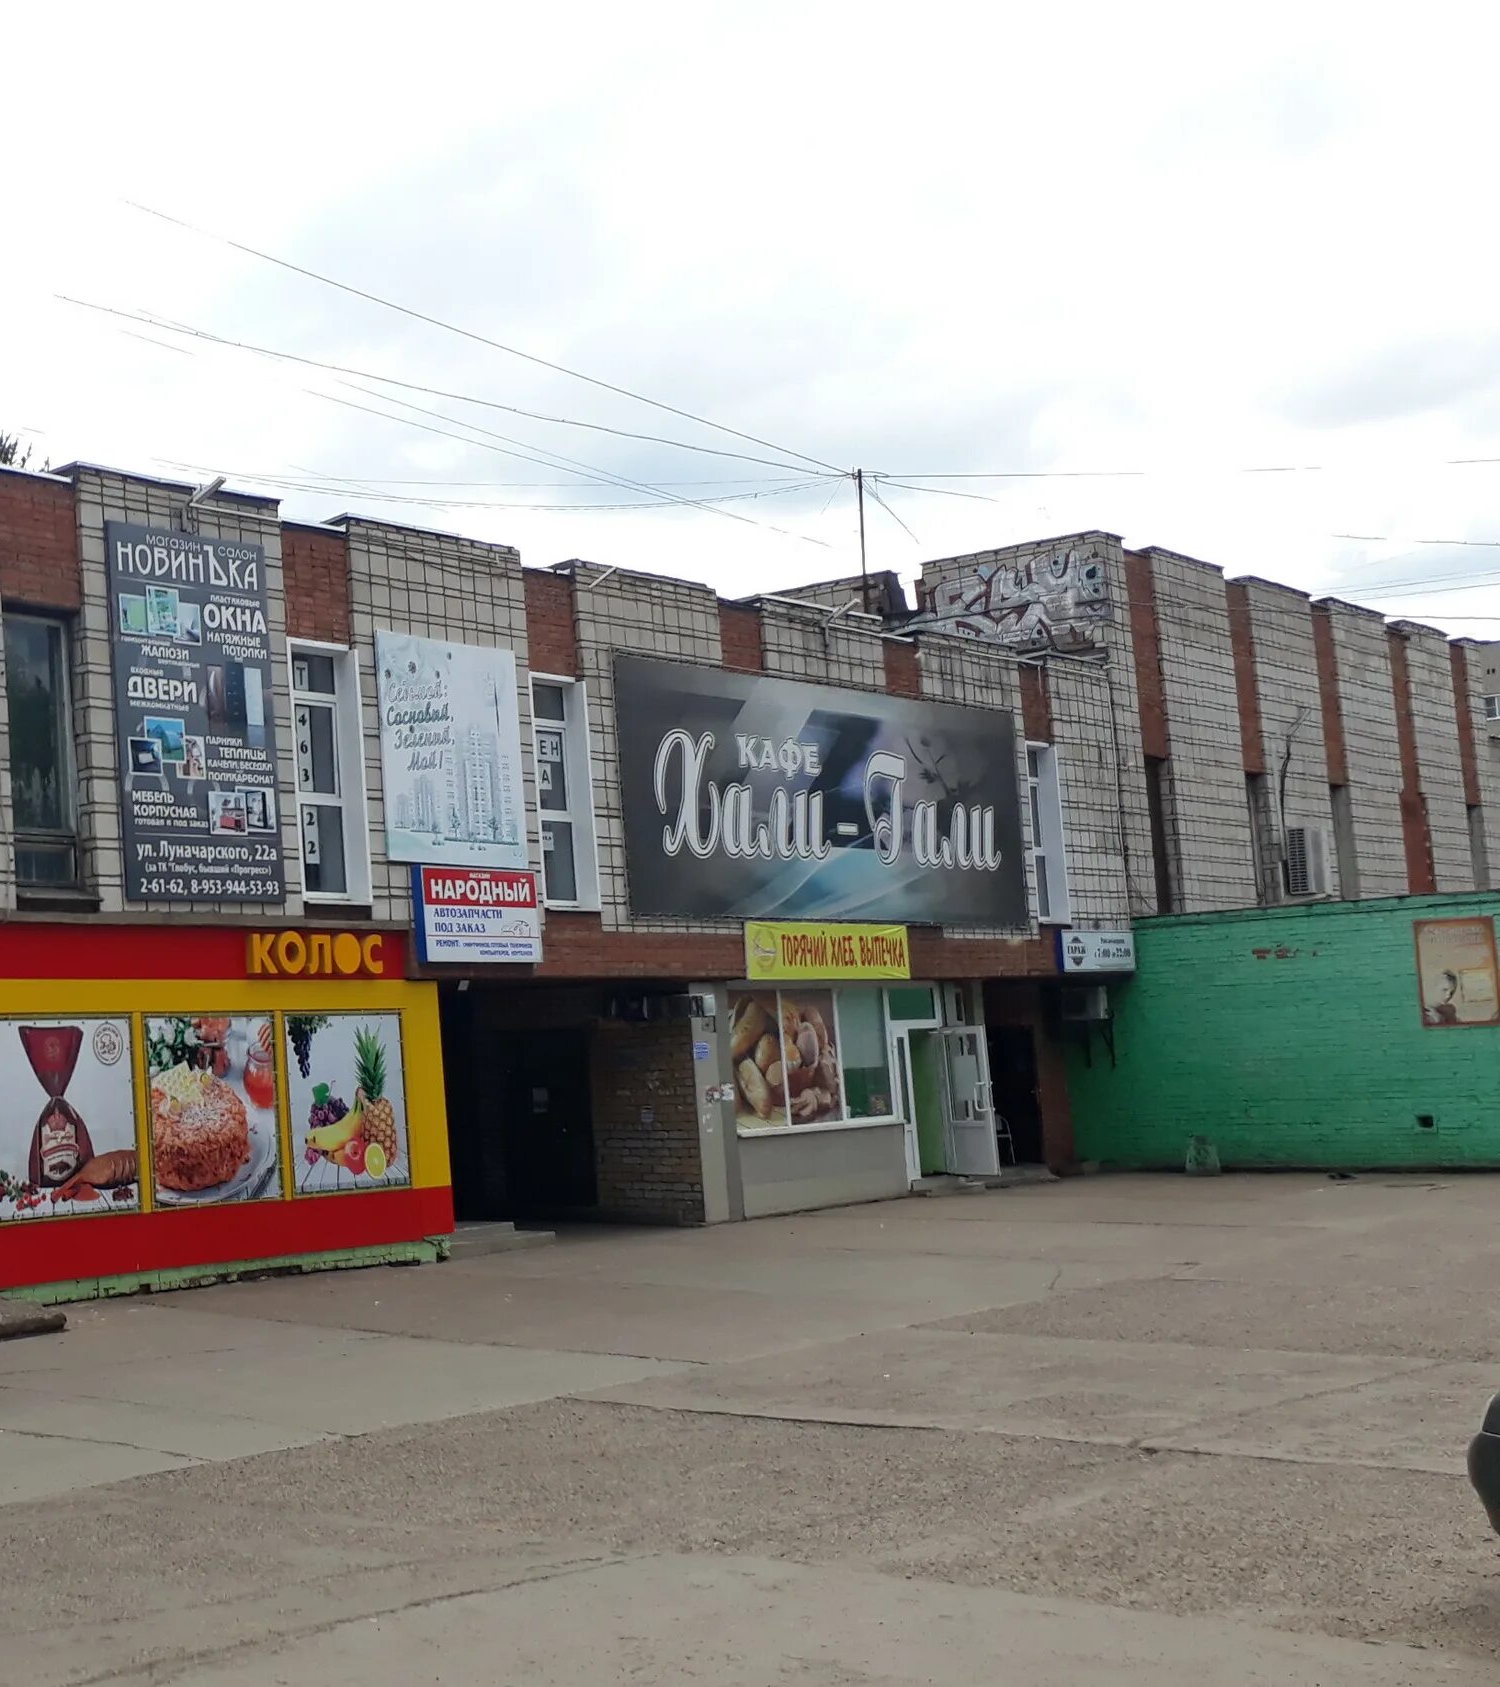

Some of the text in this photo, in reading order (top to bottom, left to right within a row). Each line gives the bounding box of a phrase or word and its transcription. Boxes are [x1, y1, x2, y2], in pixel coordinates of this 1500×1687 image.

[146, 534, 201, 553] магазин
[217, 545, 258, 561] салон
[203, 603, 267, 635] ОКНА
[206, 630, 261, 648] НАТЯЖНЫЕ
[141, 644, 190, 660] ЖАЛЮЗИ
[222, 644, 268, 660] ПОТОЛКИ
[127, 675, 198, 704] ДВЕРИ
[205, 735, 243, 747] ПАРНИКИ
[218, 746, 267, 761] ТЕПЛИЦЫ
[734, 732, 823, 781] КАФЕ
[208, 771, 275, 785] ПОЛИКАРБОНАТ
[132, 790, 175, 804] МЕБЕЛЬ
[133, 804, 198, 819] КОРПУСНАЯ
[136, 840, 278, 863] ул. Луначарского, 22а
[140, 877, 280, 896] 2-61-62, 8-953-944-53-93
[430, 877, 531, 904] НАРОДНЫЙ
[433, 907, 503, 919] АВТОЗАПЧАСТИ
[435, 922, 486, 933] ПОД ЗАКАЗ
[247, 930, 384, 975] КОЛОС
[781, 929, 907, 969] ГОРЯЧИЙ ХЛЕБ, ВЫПЕЧКА
